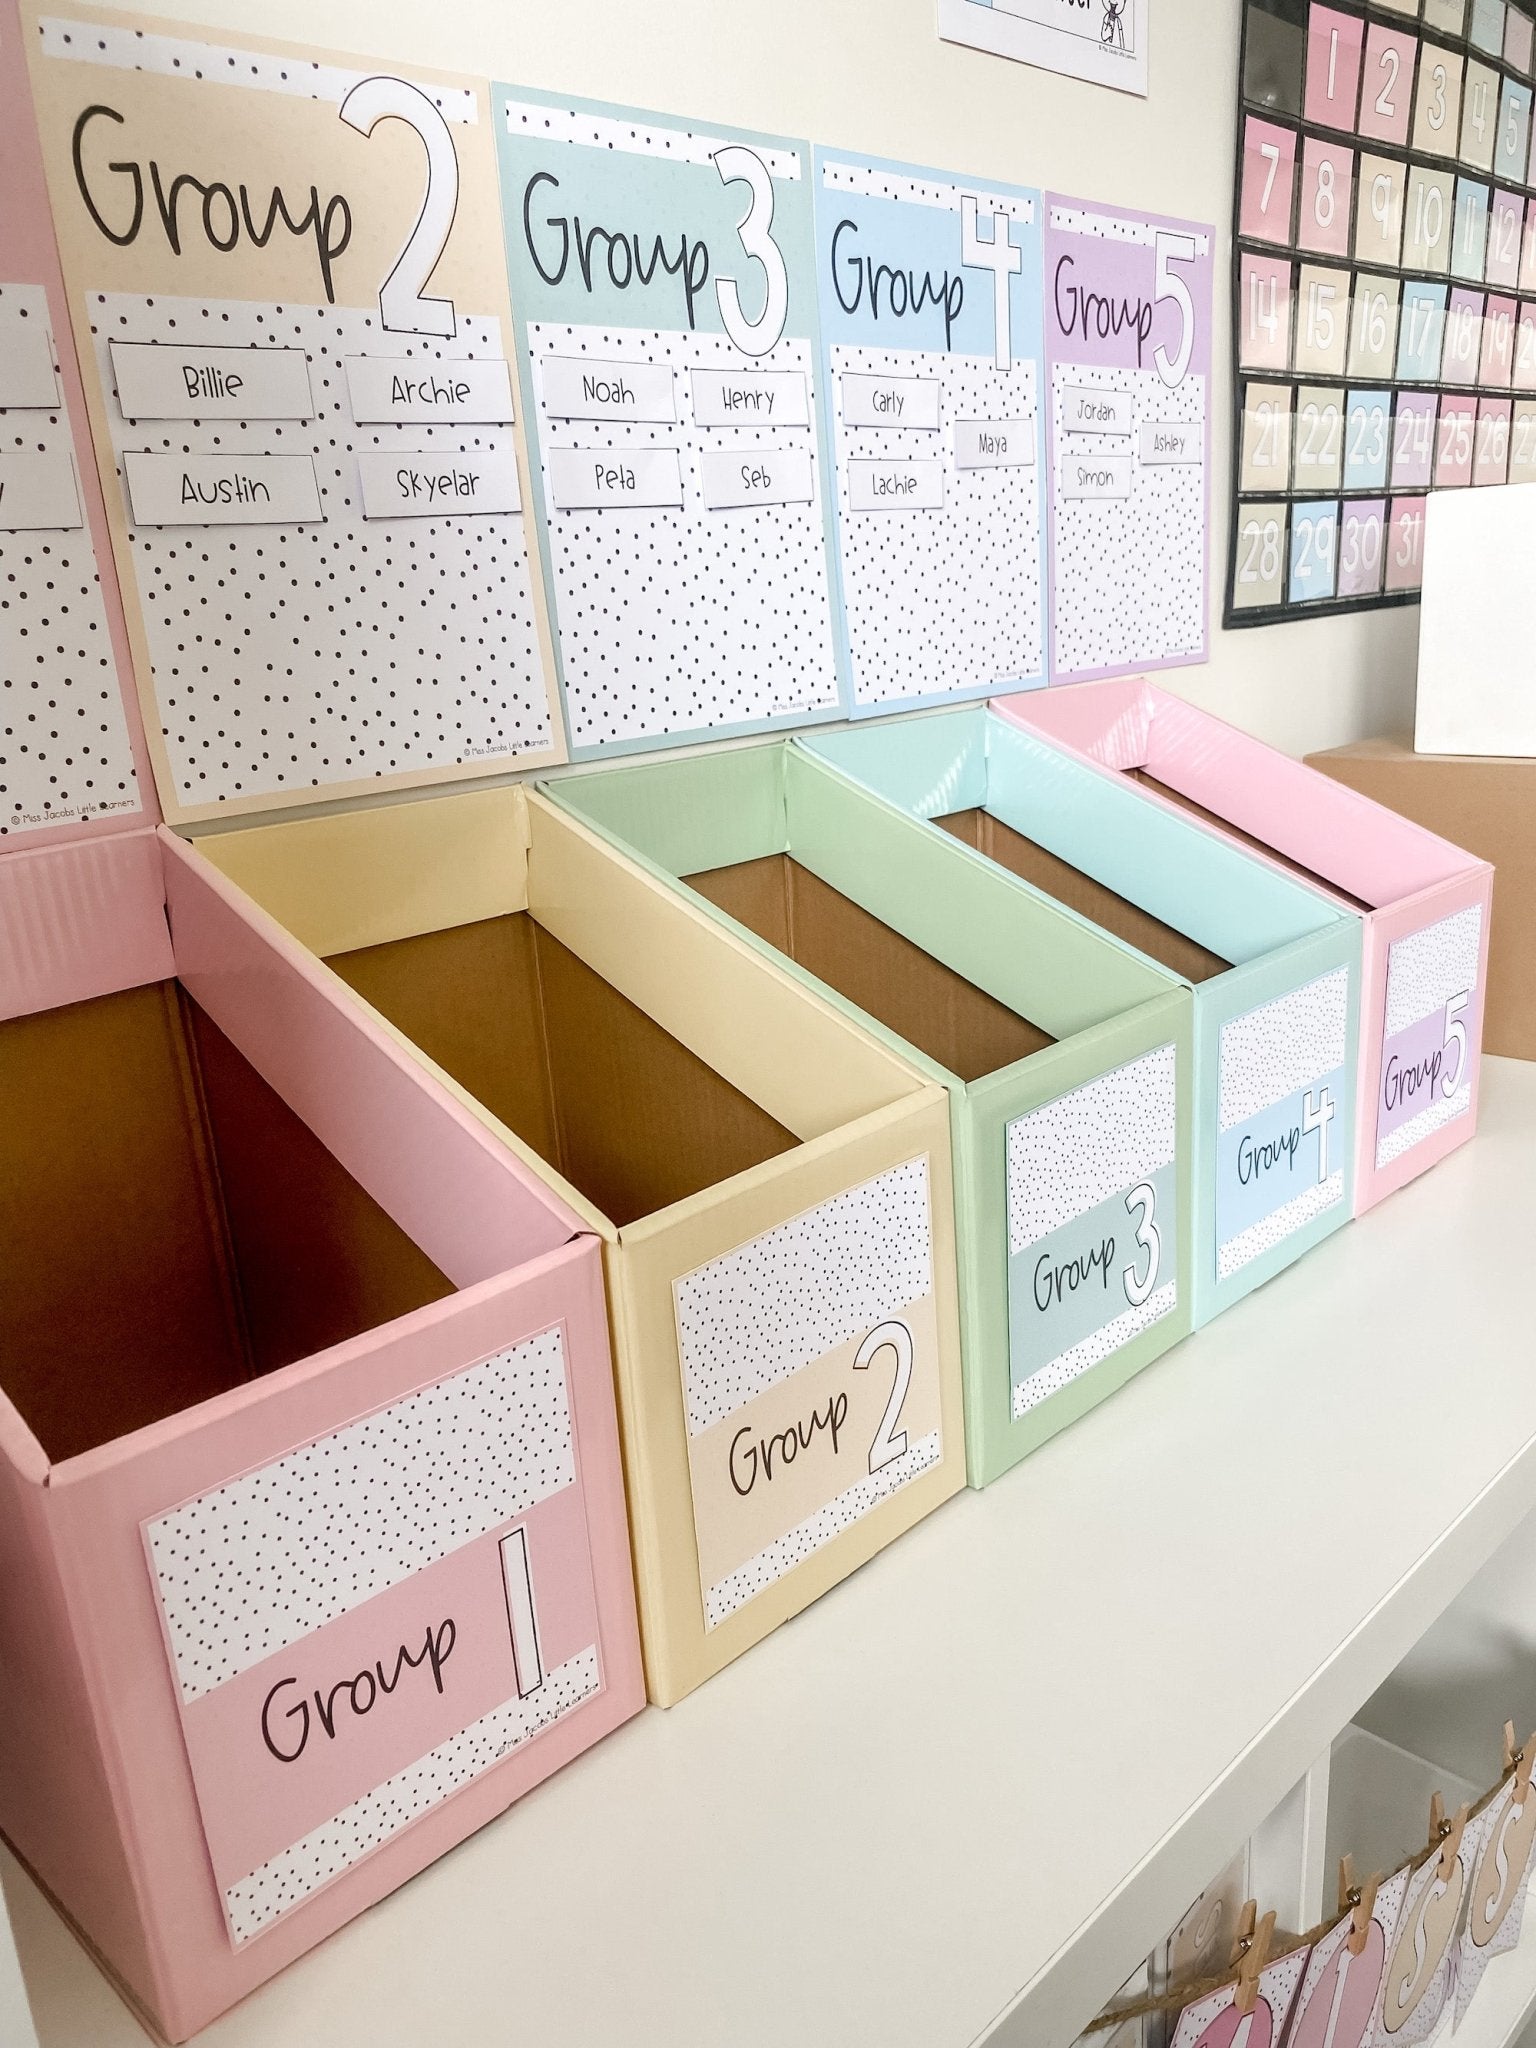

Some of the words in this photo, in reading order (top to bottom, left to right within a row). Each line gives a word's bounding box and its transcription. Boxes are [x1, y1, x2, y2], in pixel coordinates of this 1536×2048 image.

[1327, 28, 1338, 100] 1
[1375, 47, 1400, 117] 2
[1427, 64, 1446, 130] 3
[1471, 81, 1488, 144] 4
[1506, 95, 1520, 157] 5
[72, 104, 352, 304] Group
[339, 76, 460, 338] 2
[1260, 142, 1280, 215] 7
[1314, 160, 1335, 228] 8
[1371, 173, 1392, 240] 9
[1414, 182, 1443, 248] 10
[1495, 203, 1516, 265] 12
[523, 172, 709, 330] Group
[713, 146, 789, 357] 3
[831, 220, 964, 351] Group
[961, 195, 1022, 371] 4
[1055, 255, 1152, 367] Group
[1153, 231, 1196, 389] 5
[1249, 271, 1279, 344] 14
[1306, 281, 1336, 350] 15
[1358, 289, 1390, 354] 16
[1407, 296, 1434, 358] 17
[1452, 302, 1474, 361] 18
[1489, 309, 1510, 366] 19
[1518, 317, 1536, 369] 2
[183, 366, 243, 399] Billie
[391, 377, 470, 405] Archie
[583, 375, 635, 404] Noah
[722, 386, 774, 415] Henry
[872, 390, 904, 417] Carly
[1077, 399, 1116, 421] Jordan
[979, 433, 1007, 456] Maya
[1154, 433, 1185, 453] Ashley
[1250, 400, 1280, 467] 21
[1299, 402, 1338, 466] 22
[1347, 404, 1384, 466] 23
[1395, 407, 1432, 464] 24
[1439, 410, 1472, 465] 25
[1478, 412, 1507, 465] 26
[181, 473, 270, 504] Austin
[396, 470, 480, 502] Skyelar
[595, 464, 636, 490] Peta
[741, 466, 771, 489] Seb
[872, 473, 918, 497] Lachie
[1077, 467, 1114, 487] Simon
[1238, 519, 1280, 584] 28
[1293, 513, 1336, 579] 29
[1342, 514, 1381, 574] 30
[1395, 511, 1422, 568] 31
[44, 807, 75, 820] Jacobs
[1384, 1050, 1442, 1111] Group
[1441, 988, 1469, 1099] 5
[1238, 1126, 1300, 1185] Group
[1302, 1087, 1335, 1184] 4
[1034, 1237, 1115, 1312] Group
[1123, 1183, 1161, 1307] 3
[730, 1392, 848, 1496] Group
[853, 1320, 914, 1475] 2
[261, 1618, 457, 1763] Group
